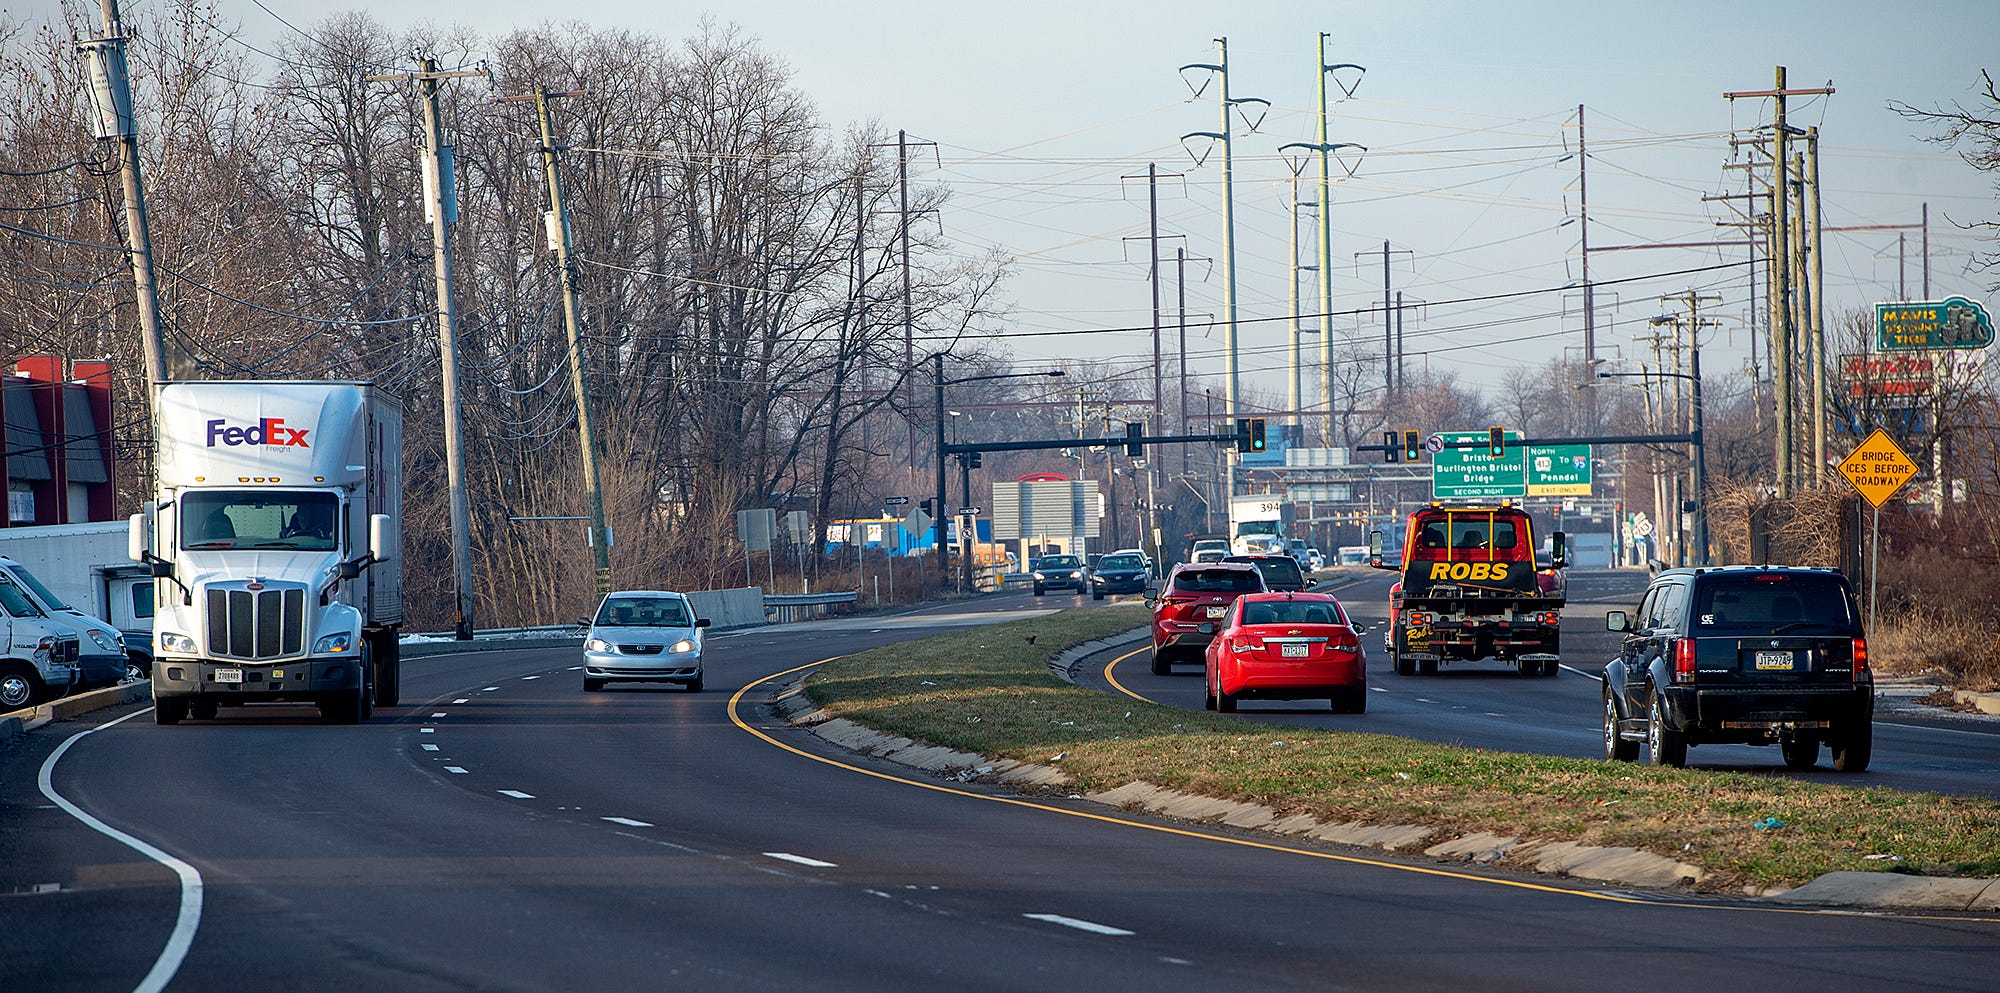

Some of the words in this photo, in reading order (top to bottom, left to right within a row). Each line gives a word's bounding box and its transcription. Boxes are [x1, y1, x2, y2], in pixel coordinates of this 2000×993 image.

[1883, 310, 1937, 321] MAVIS
[206, 417, 310, 448] FedEx
[265, 445, 292, 453] Freight
[1862, 451, 1896, 461] BRIDGE
[1436, 465, 1487, 474] Burlington
[1489, 464, 1521, 472] Bristol
[1536, 460, 1551, 468] 413
[1574, 459, 1585, 469] 95
[1846, 463, 1867, 473] ICES
[1874, 464, 1910, 474] BEFORE
[1463, 474, 1494, 484] Bridge
[1540, 473, 1579, 482] Penndel
[1855, 475, 1900, 486] ROADWAY
[1260, 502, 1280, 512] 394
[1429, 562, 1510, 581] ROBS
